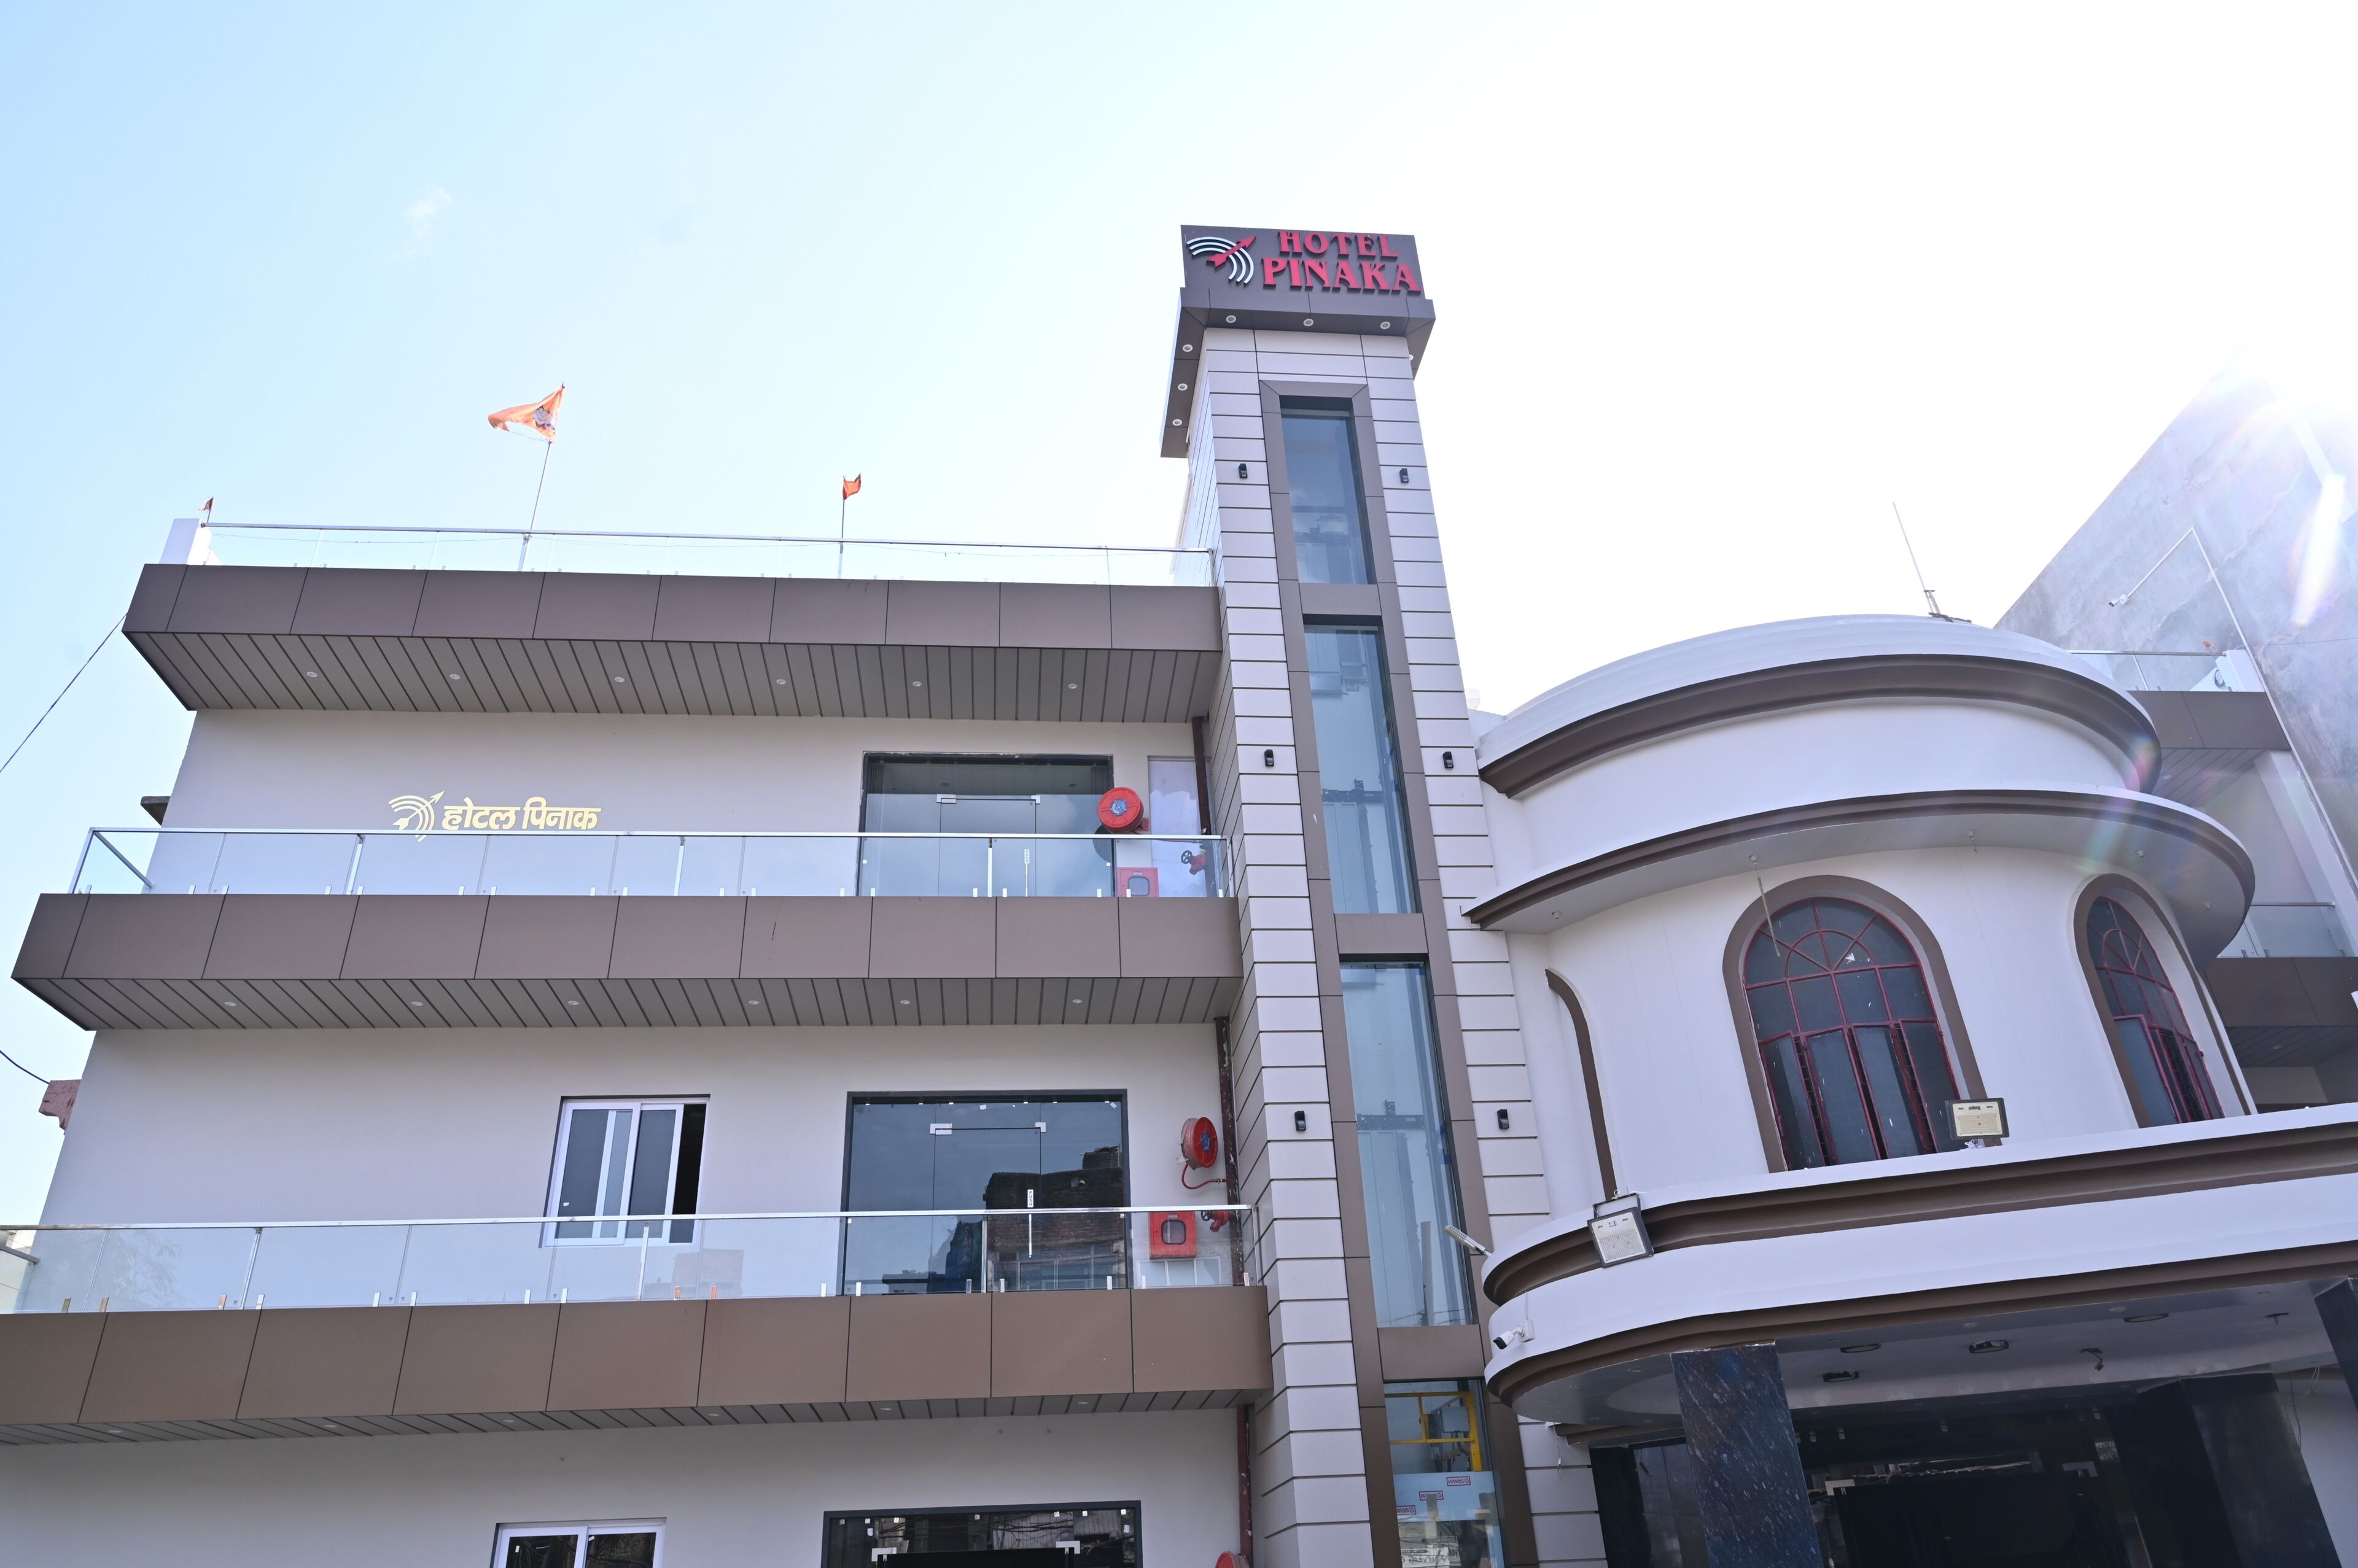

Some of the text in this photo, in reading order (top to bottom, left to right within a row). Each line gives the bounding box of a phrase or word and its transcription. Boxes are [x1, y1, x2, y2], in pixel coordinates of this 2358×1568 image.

[1277, 230, 1399, 260] HOTEL
[1261, 257, 1422, 295] PINAKA
[442, 796, 602, 831] होटल पिनाक
